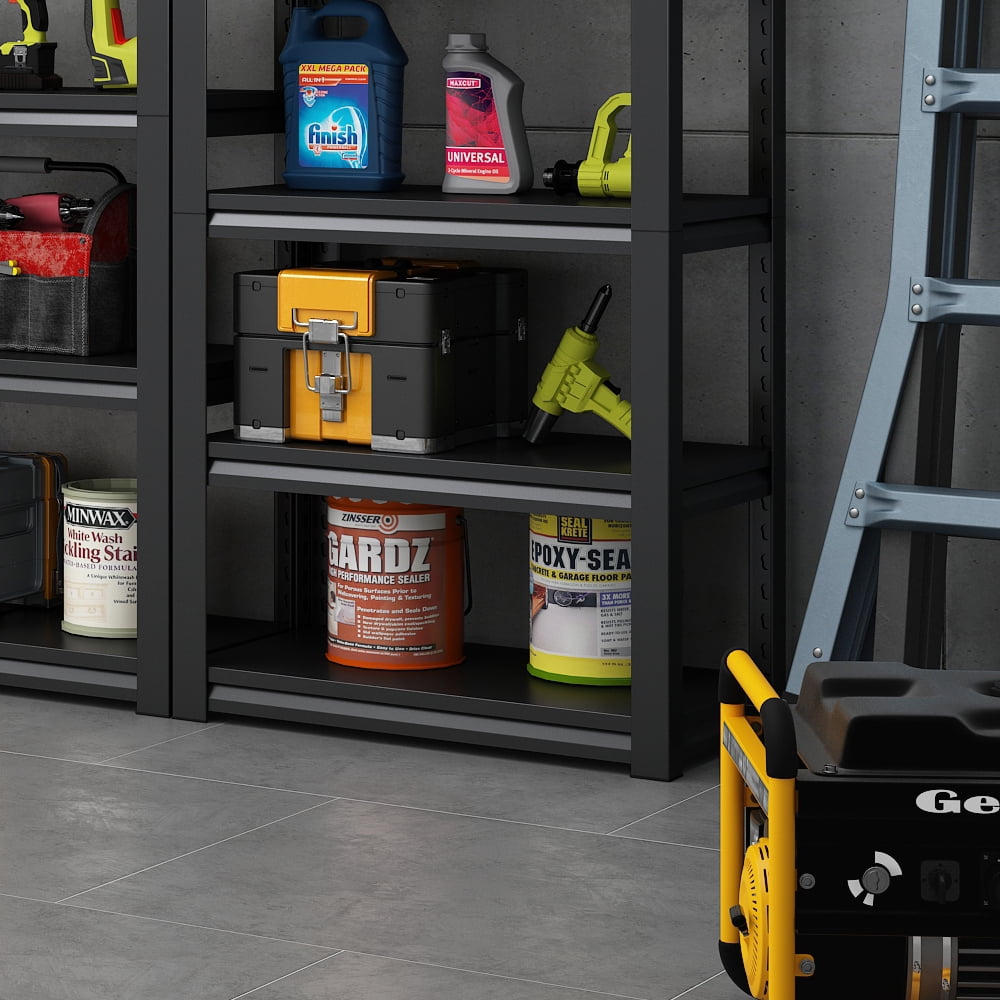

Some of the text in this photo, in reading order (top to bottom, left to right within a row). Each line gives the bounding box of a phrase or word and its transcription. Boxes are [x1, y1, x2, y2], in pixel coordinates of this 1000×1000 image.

[300, 64, 366, 73] XXL MEGA PACK
[308, 123, 358, 145] finish
[447, 151, 505, 163] UNIVERSAL
[341, 513, 380, 524] ZINSSER
[561, 517, 587, 528] SEAL
[68, 527, 123, 544] White Wash
[561, 527, 588, 537] KRETE
[328, 531, 431, 573] GARDZ
[338, 570, 395, 585] PERFORMANCE
[398, 573, 431, 584] SEALER
[559, 572, 590, 582] GARAGE
[592, 573, 618, 582] FLOOR
[404, 593, 432, 601] Texturing
[612, 592, 630, 600] MORE
[357, 606, 390, 614] Penetrates
[916, 789, 1000, 814] Ge
